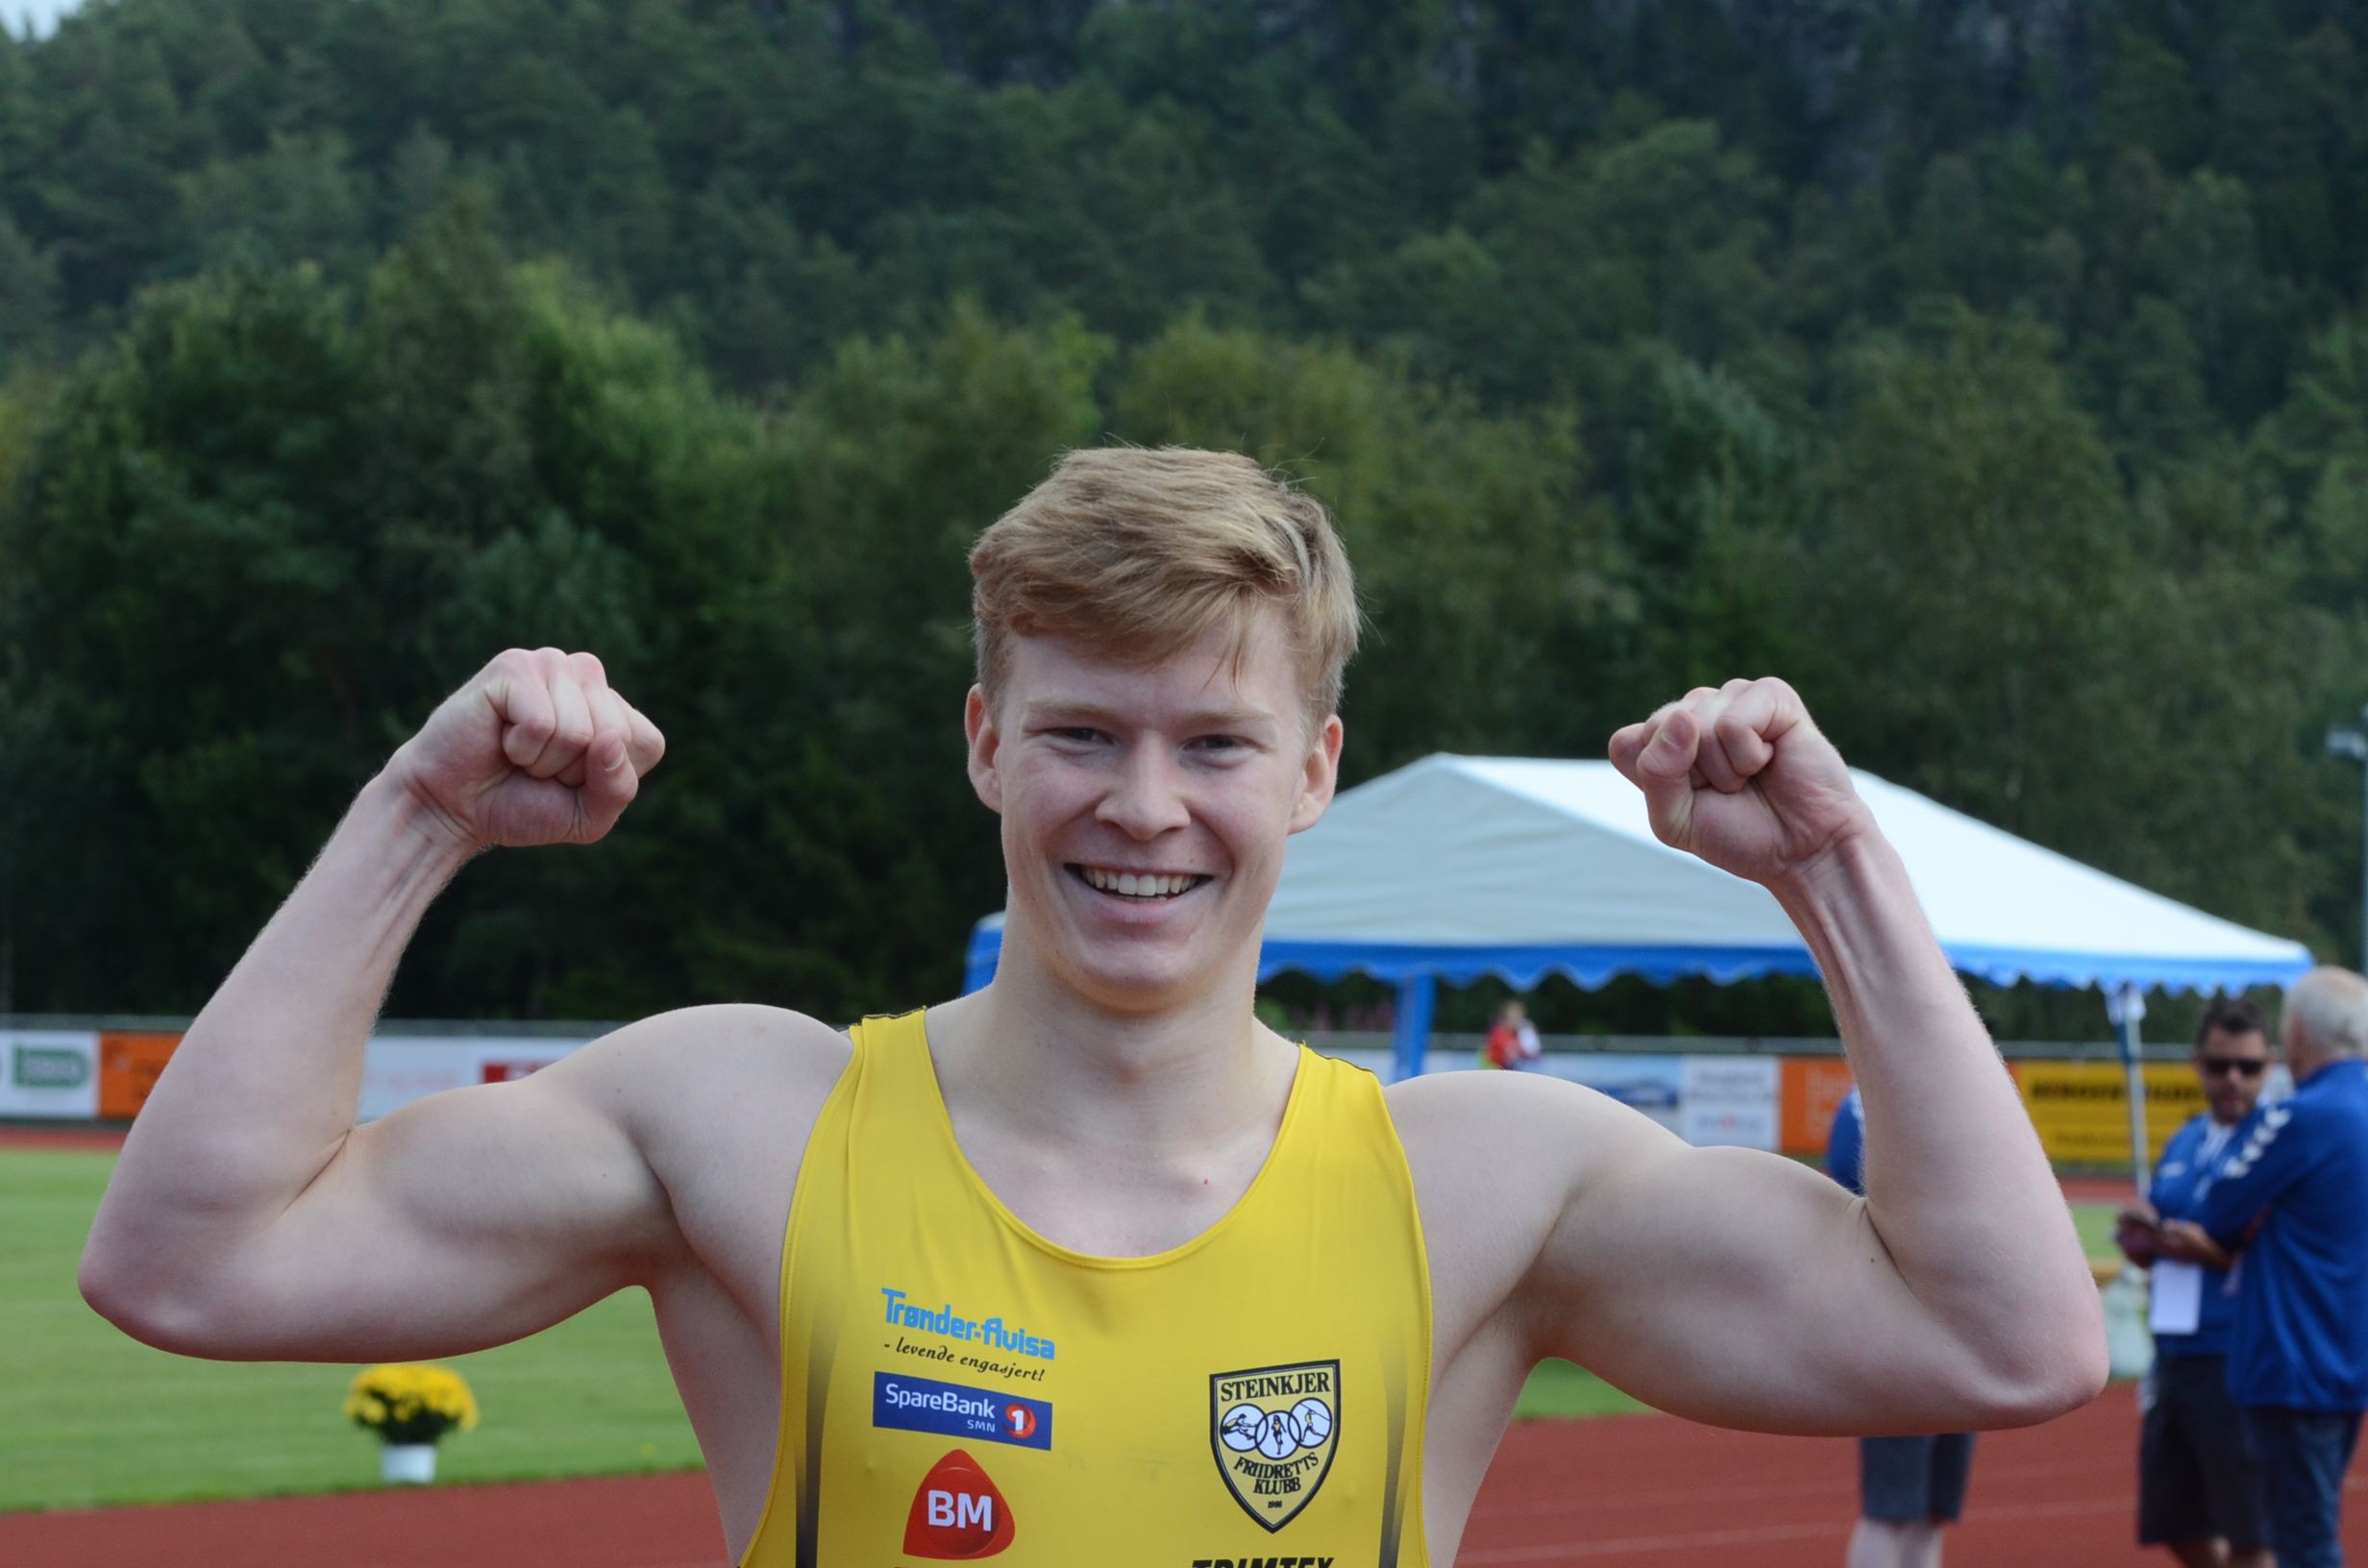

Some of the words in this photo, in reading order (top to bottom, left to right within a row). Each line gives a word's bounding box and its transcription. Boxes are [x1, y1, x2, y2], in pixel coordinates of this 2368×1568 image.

[881, 1287, 1055, 1360] Trønder-Avisa
[896, 1337, 954, 1362] levende
[960, 1355, 1045, 1382] engasjert!
[1221, 1372, 1331, 1402] STEINKJER
[885, 1384, 996, 1419] SpareBank
[1012, 1409, 1024, 1434] 1
[967, 1419, 996, 1433] SMN
[1233, 1452, 1320, 1480] FRIIDRETTS
[1253, 1477, 1302, 1495] KLUBB
[928, 1489, 994, 1531] BM
